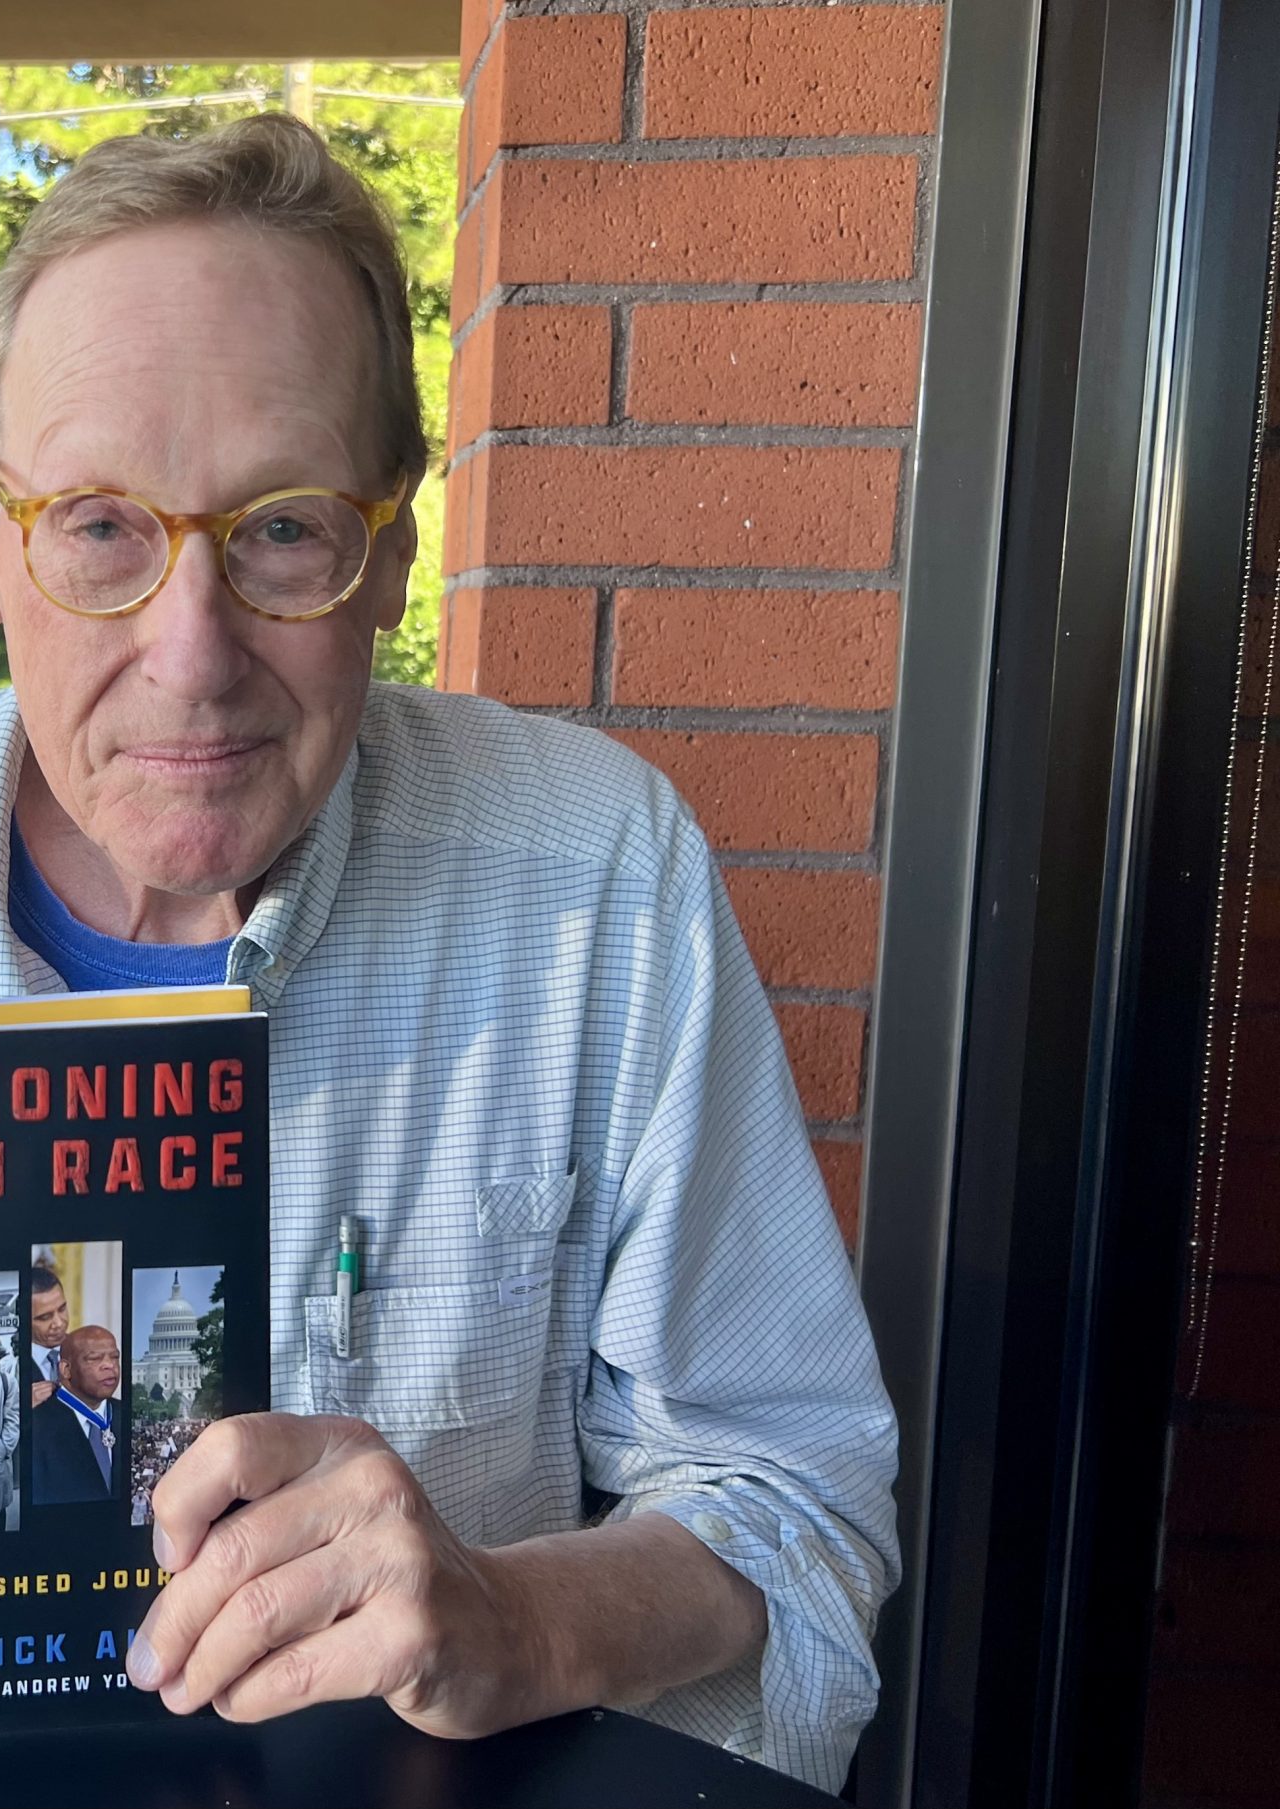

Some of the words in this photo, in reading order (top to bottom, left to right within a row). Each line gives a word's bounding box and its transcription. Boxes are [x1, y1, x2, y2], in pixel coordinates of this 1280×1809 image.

[53, 1132, 244, 1196] RACE
[96, 1629, 135, 1659] A
[2, 1675, 90, 1696] ANDREW
